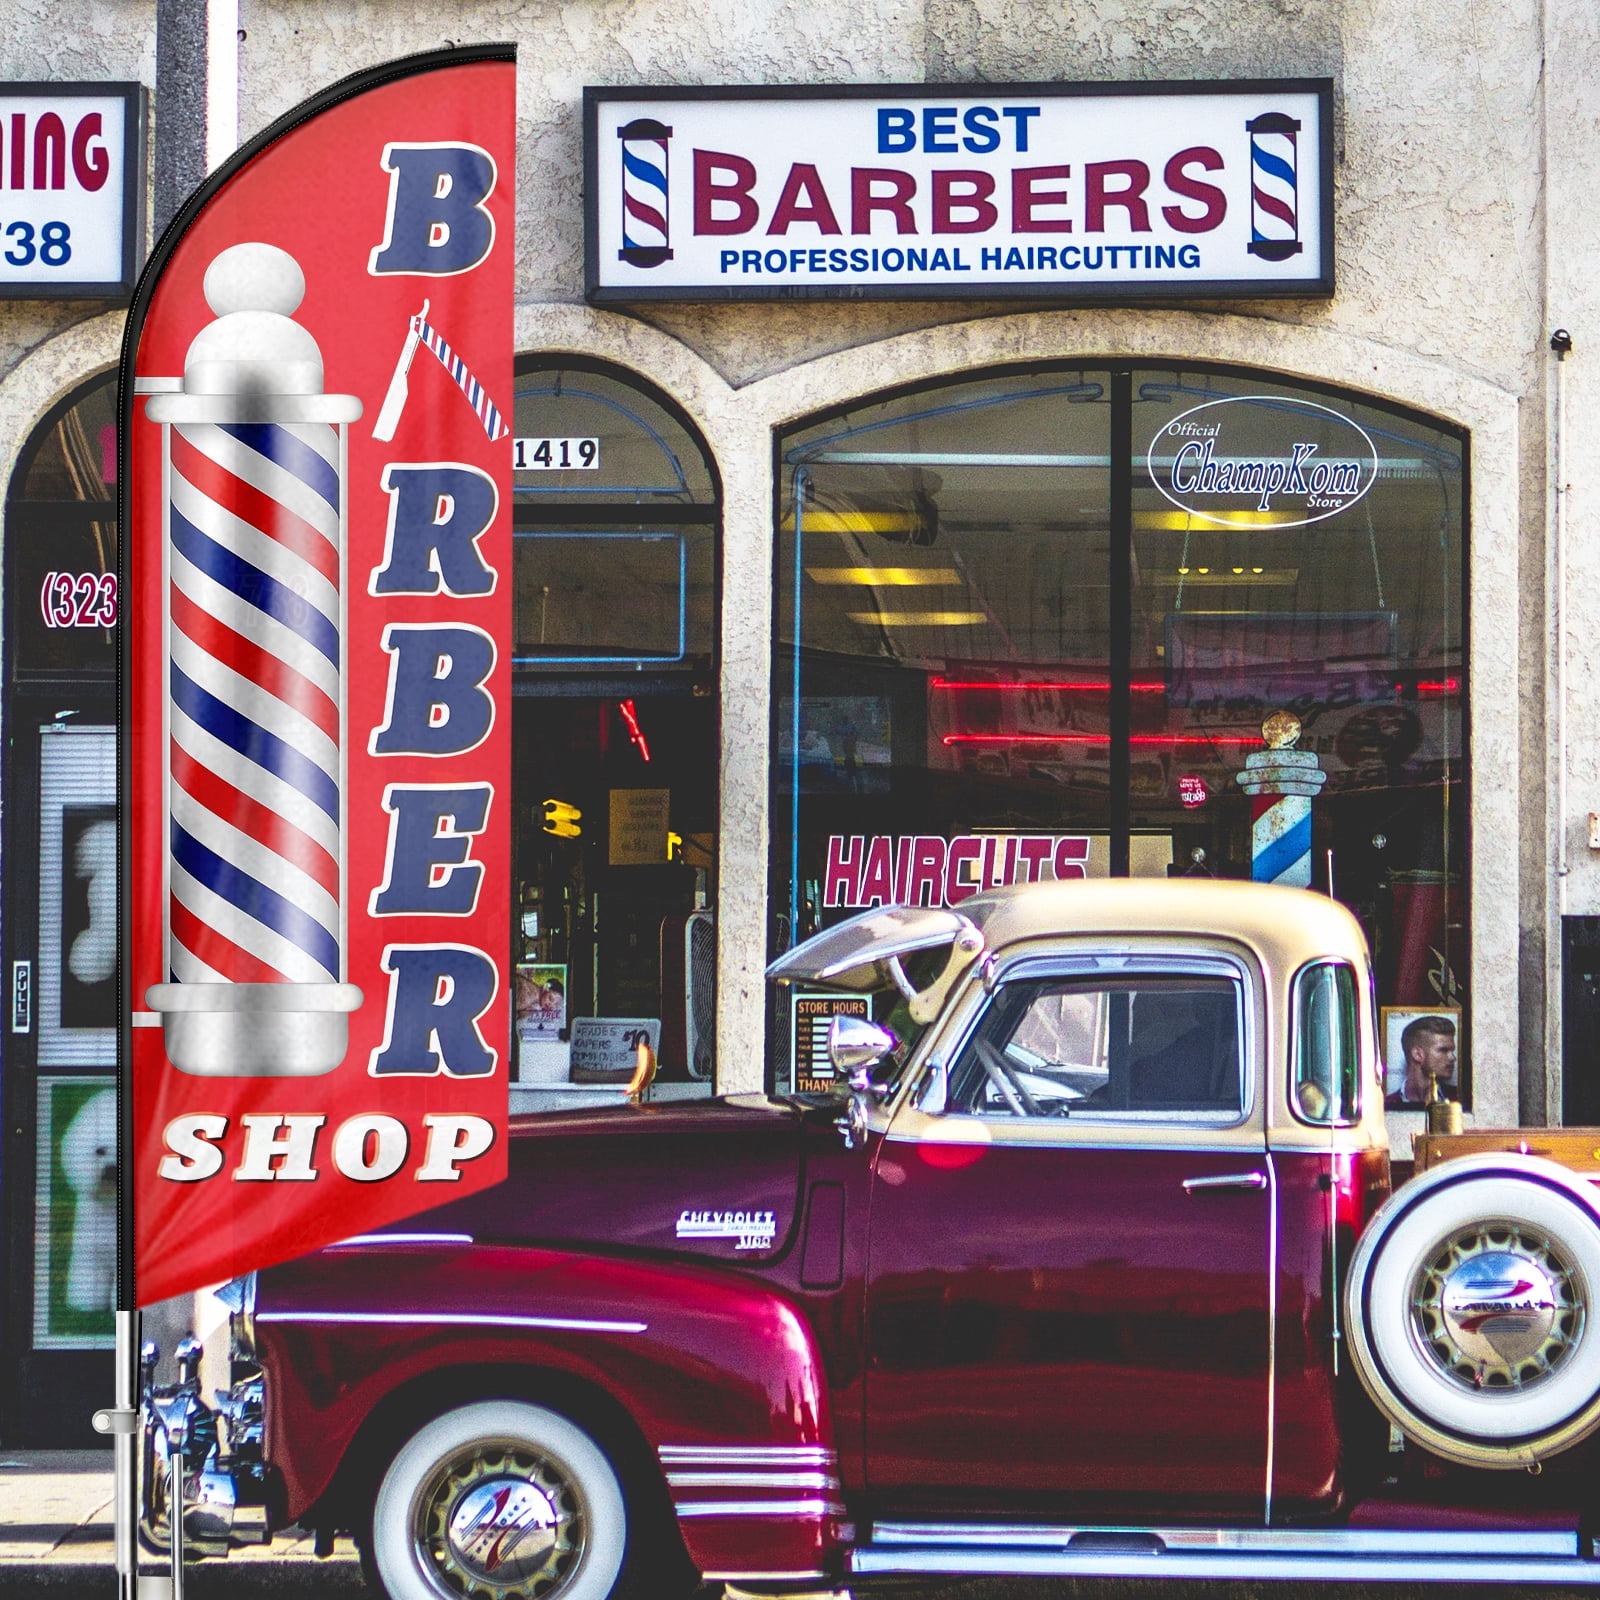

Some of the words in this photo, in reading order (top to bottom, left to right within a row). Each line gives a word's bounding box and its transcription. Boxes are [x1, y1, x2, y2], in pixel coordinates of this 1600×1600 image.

[0, 112, 110, 192] ING
[877, 106, 1041, 154] BEST
[692, 146, 1228, 237] BARBERS
[0, 221, 72, 266] 38
[720, 247, 971, 274] PROFESSIONAL
[981, 245, 1201, 271] HAIRCUTTING
[1168, 422, 1221, 437] Official
[515, 439, 597, 467] 1419
[1171, 438, 1361, 511] ChampKom
[1307, 495, 1342, 508] Store
[41, 572, 117, 628] (323
[823, 835, 1091, 909] HAIRCUTS
[17, 970, 27, 1013] PULL
[798, 1001, 829, 1014] STORE
[832, 1001, 865, 1014] HOURS
[157, 1112, 497, 1182] SHOP
[680, 1210, 774, 1224] CHEVROLET
